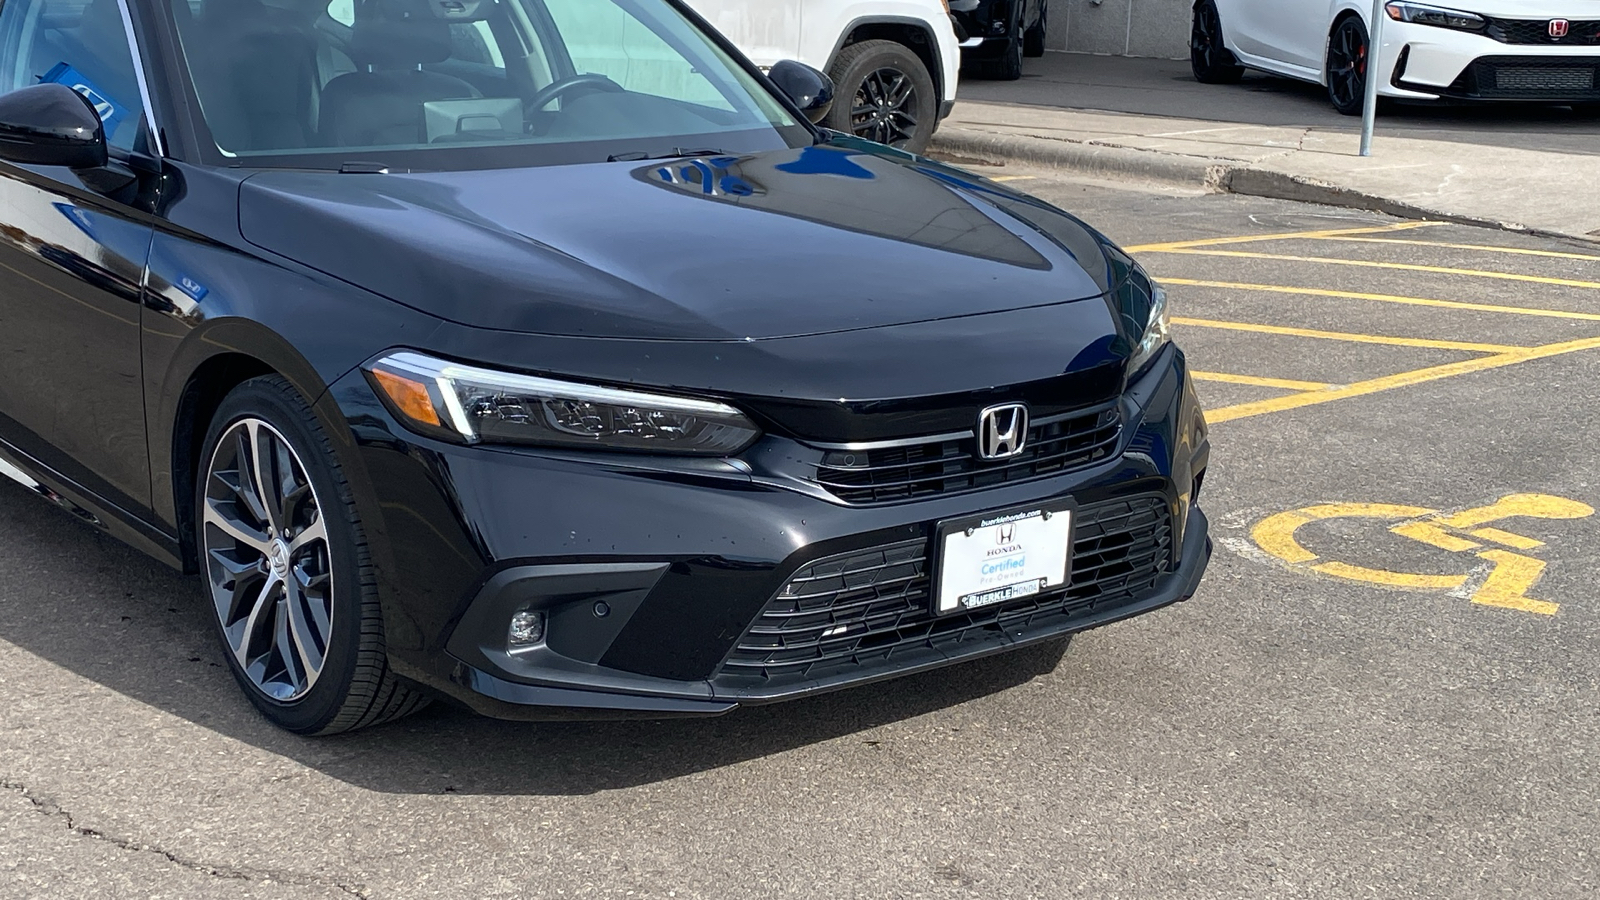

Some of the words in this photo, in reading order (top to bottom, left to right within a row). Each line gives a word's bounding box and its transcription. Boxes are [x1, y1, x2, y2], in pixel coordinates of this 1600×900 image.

[981, 510, 1041, 527] buerklehonda.com
[987, 544, 1022, 556] HONDA
[981, 556, 1025, 575] Certified
[980, 569, 1024, 584] Pre-Owned
